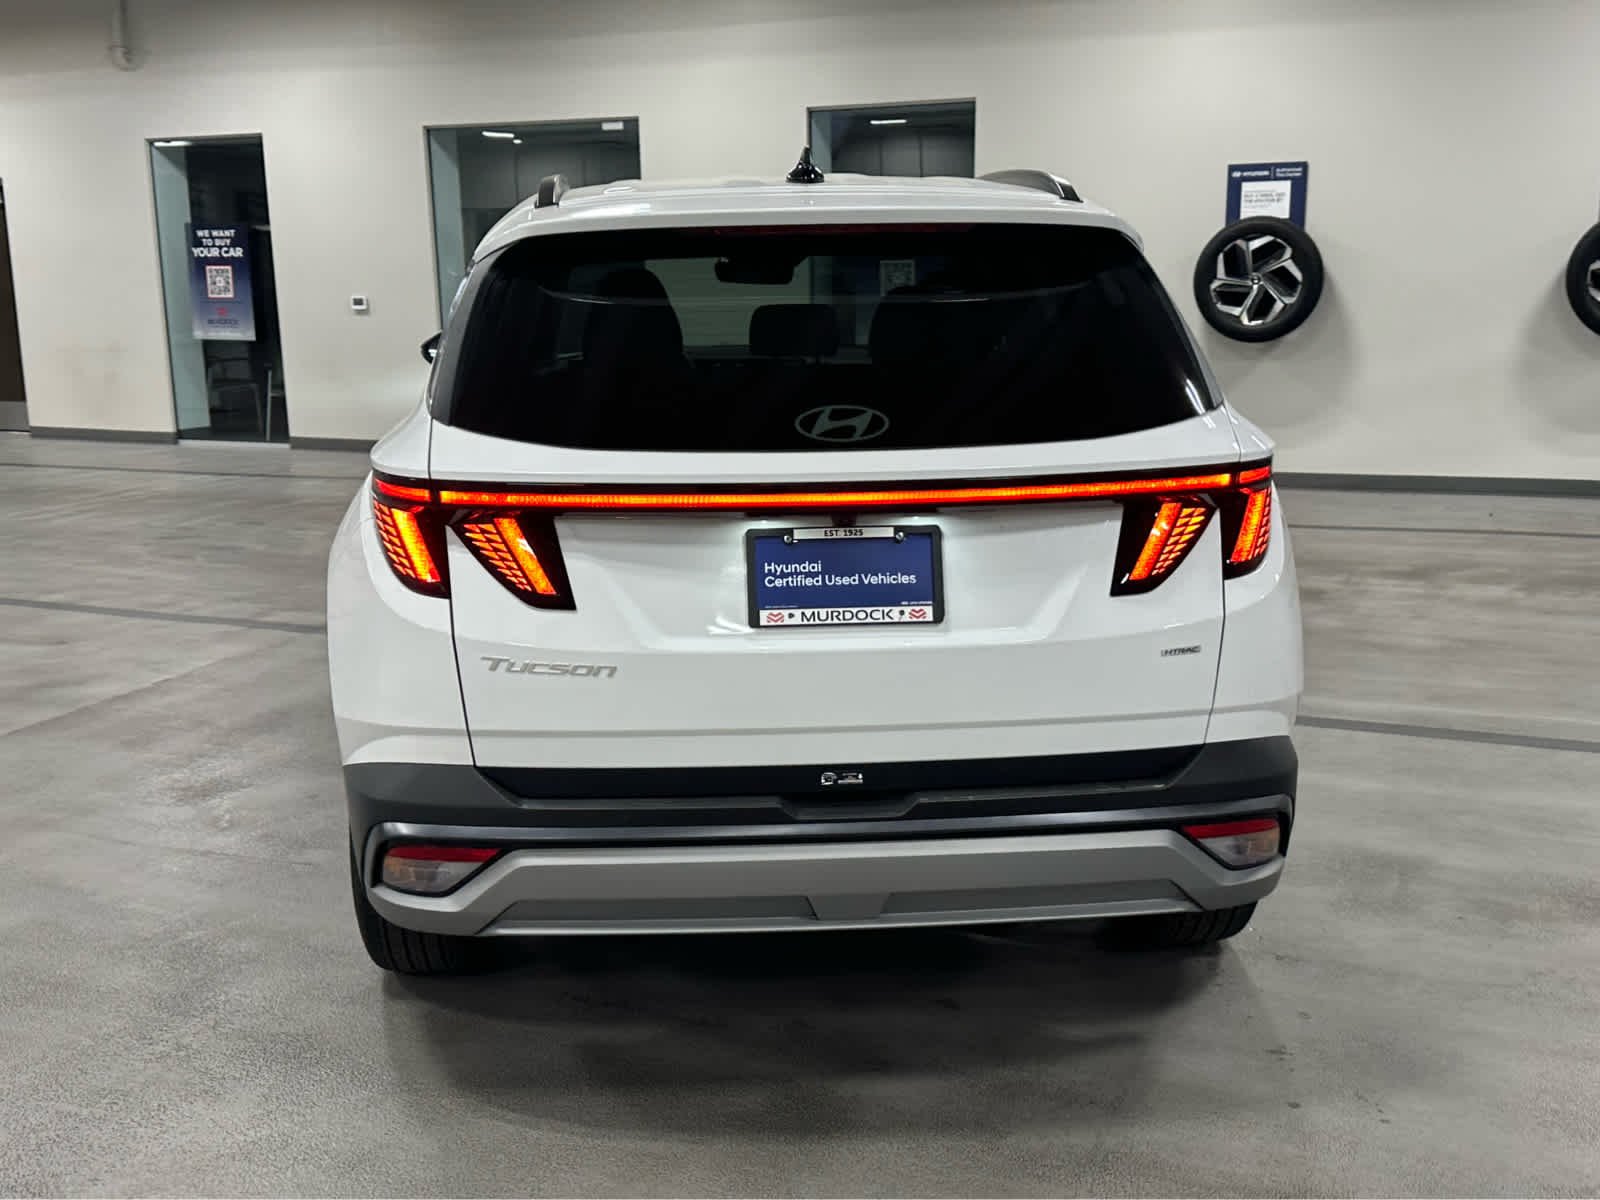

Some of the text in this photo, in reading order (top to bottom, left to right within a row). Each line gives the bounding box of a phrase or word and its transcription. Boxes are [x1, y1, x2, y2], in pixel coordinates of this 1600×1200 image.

[196, 229, 236, 238] WE WANT
[202, 238, 213, 246] TO
[192, 247, 243, 257] YOUR CAR
[843, 529, 864, 537] 1925
[764, 560, 822, 576] Hyundai
[764, 572, 917, 588] Certified Used Vehicles
[800, 608, 894, 623] MURDOCK
